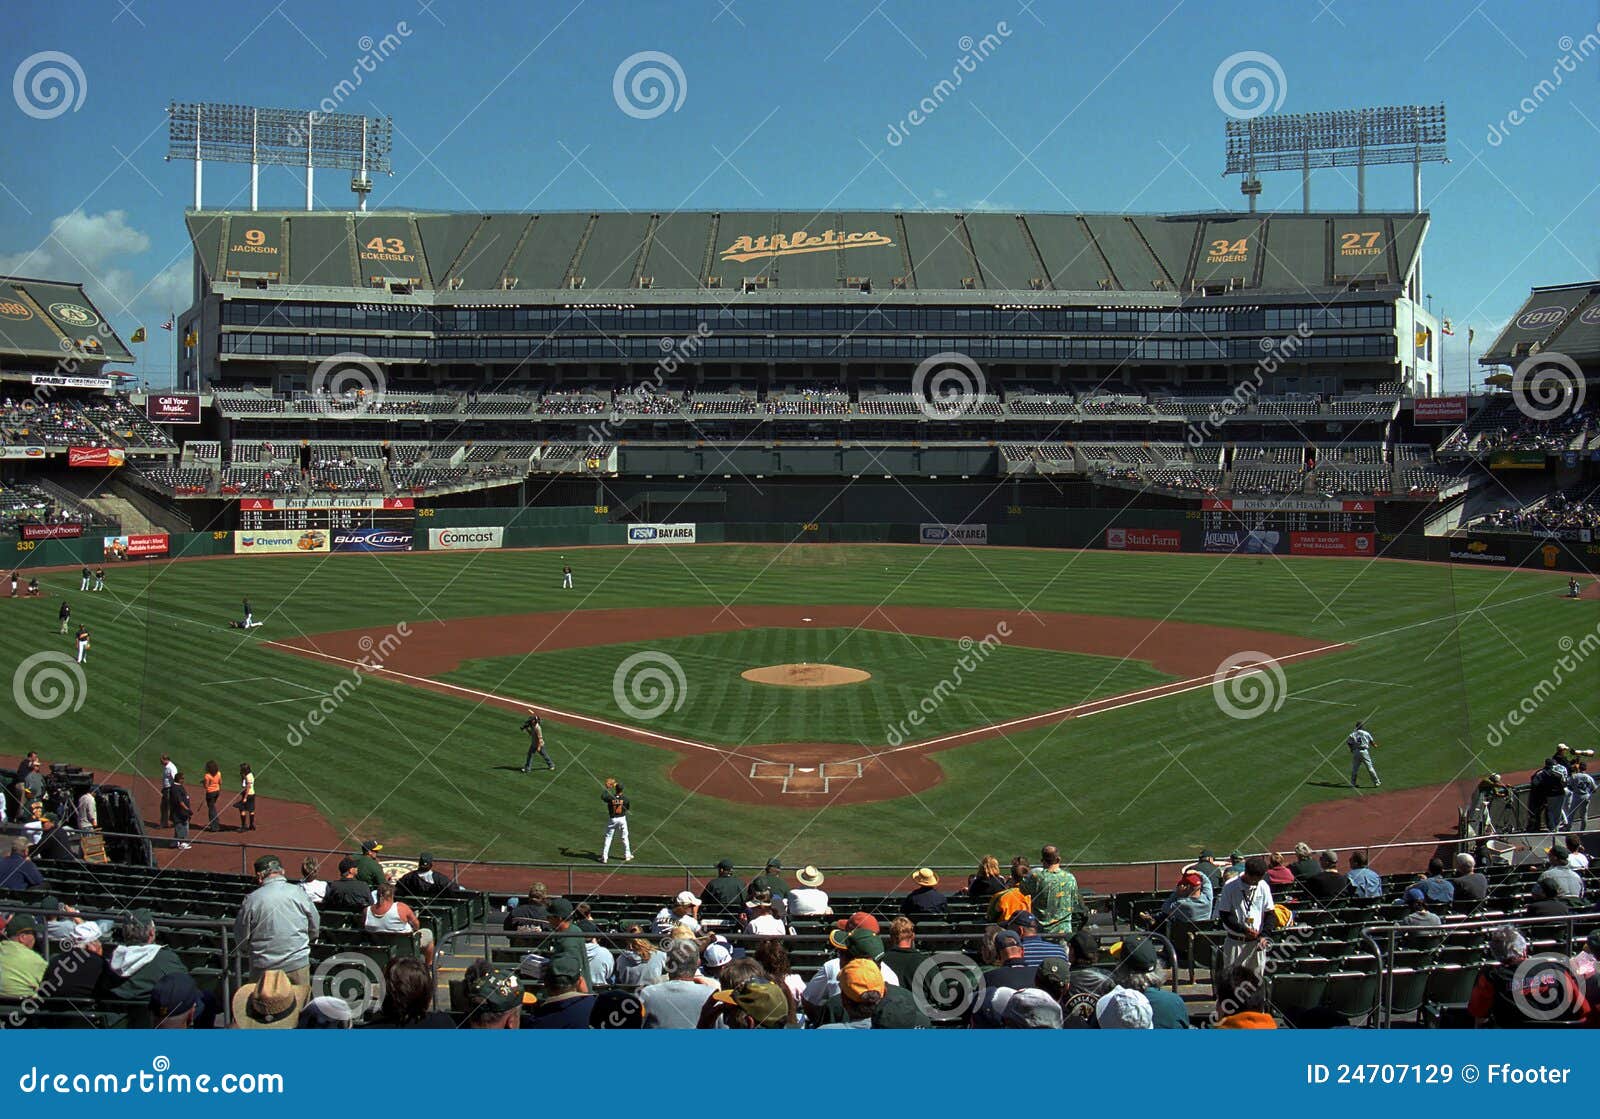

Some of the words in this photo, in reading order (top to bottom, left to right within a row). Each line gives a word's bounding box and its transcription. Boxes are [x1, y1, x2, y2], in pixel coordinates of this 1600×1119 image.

[245, 229, 266, 246] 9
[1341, 231, 1381, 249] 27
[231, 244, 278, 254] JACKSON
[367, 237, 406, 254] 43
[720, 229, 891, 259] Athletics
[1209, 238, 1249, 256] 34
[1341, 247, 1382, 256] HUNTER
[360, 252, 415, 262] ECKERSLEY
[1206, 254, 1248, 263] FINGERS
[1523, 311, 1563, 324] 1910
[159, 397, 172, 405] Call
[173, 397, 189, 405] Your
[1296, 501, 1331, 509] HEALTH
[418, 509, 434, 517] 362
[58, 526, 80, 535] Phoenix
[659, 528, 673, 538] BAY
[673, 528, 694, 538] AREA
[965, 529, 986, 539] AREA
[256, 537, 293, 545] Chevron
[334, 535, 366, 543] BUD
[371, 535, 413, 543] LIGHT
[441, 531, 494, 544] comcast
[1128, 535, 1151, 545] State
[1152, 534, 1178, 546] Farm
[16, 540, 35, 551] 330
